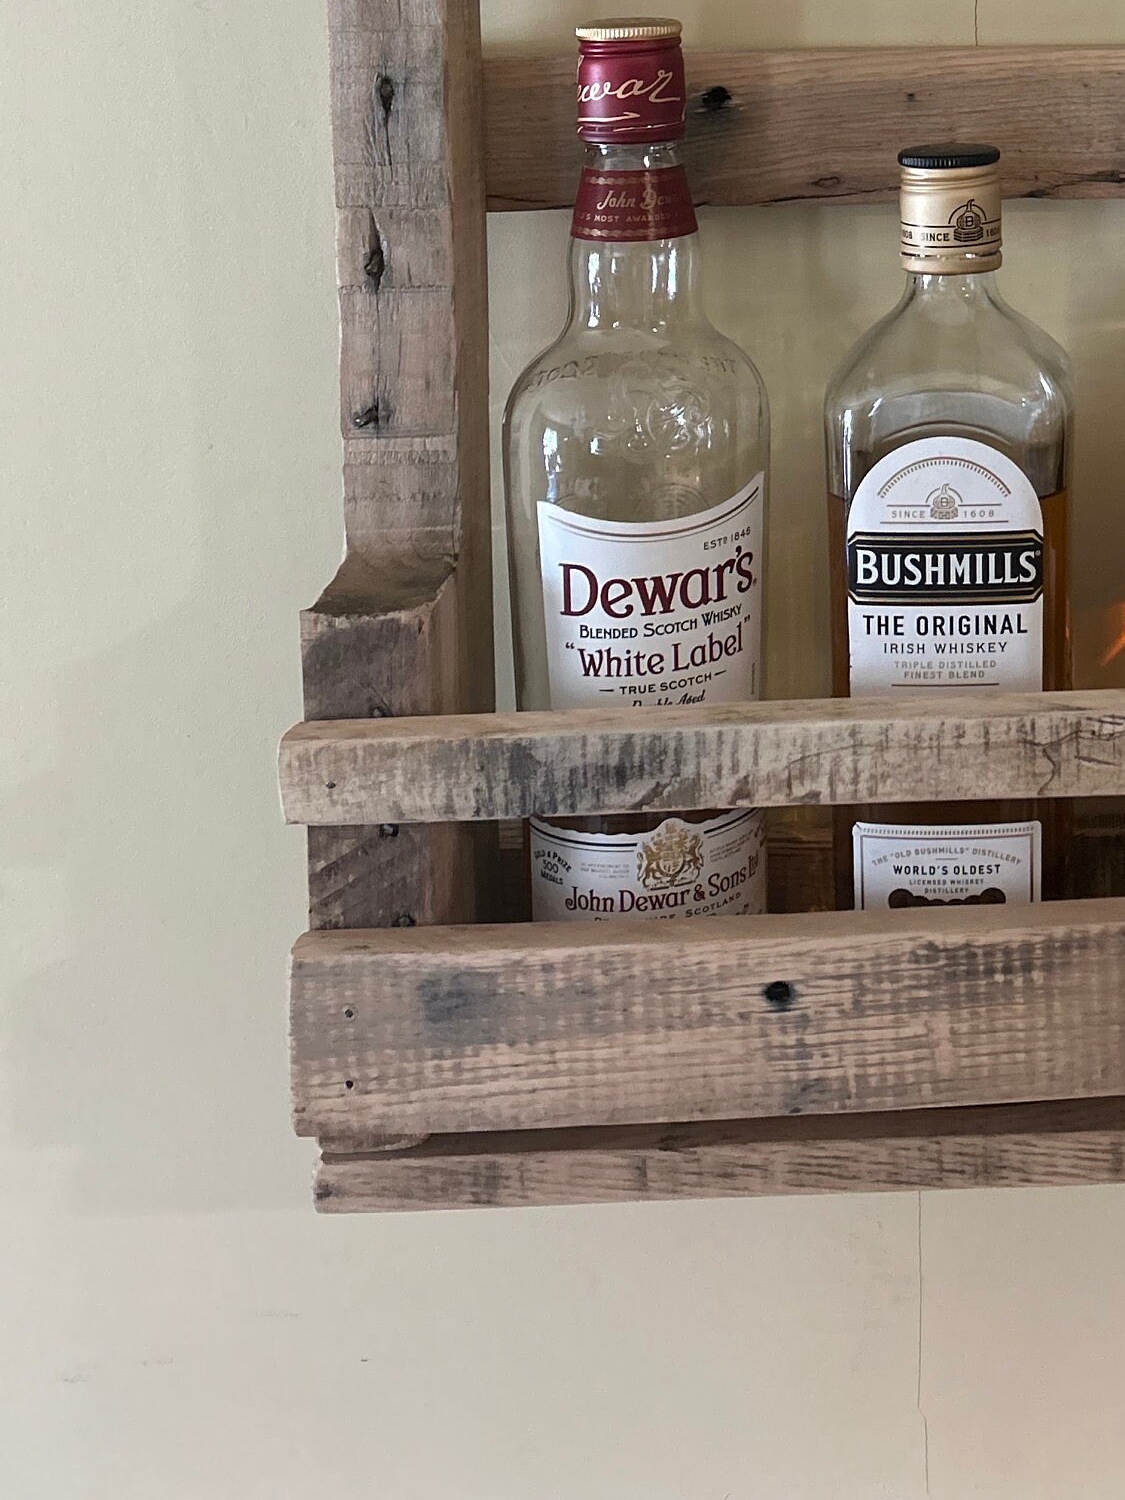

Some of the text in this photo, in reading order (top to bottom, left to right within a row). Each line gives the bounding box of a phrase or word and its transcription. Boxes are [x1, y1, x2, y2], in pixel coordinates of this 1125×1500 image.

[596, 190, 636, 210] John
[594, 214, 620, 222] MOST
[921, 232, 950, 242] SINCE
[891, 509, 995, 519] SINCE 1608
[730, 526, 751, 542] 1846
[856, 549, 1036, 585] BUSHMILLS
[558, 545, 754, 618] Dewar's
[579, 603, 742, 639] BLENDED SCOTCH WHISKY
[863, 613, 1028, 636] THE ORIGINAL
[883, 642, 1008, 654] IRISH WHISKEY
[894, 660, 997, 670] TRIPLE DISTILLED
[904, 670, 985, 679] FINEST BLEND
[619, 674, 712, 695] TRUE SCOTCH
[871, 855, 888, 867] THE
[972, 848, 1022, 866] DISTILLERY
[893, 863, 1001, 875] WORLD'S OLDEST
[565, 886, 615, 913] John
[619, 889, 690, 912] Dewar
[693, 883, 705, 902] &
[707, 866, 747, 897] Sons
[949, 878, 984, 886] WHISKEY
[685, 891, 741, 918] SCOTLAND
